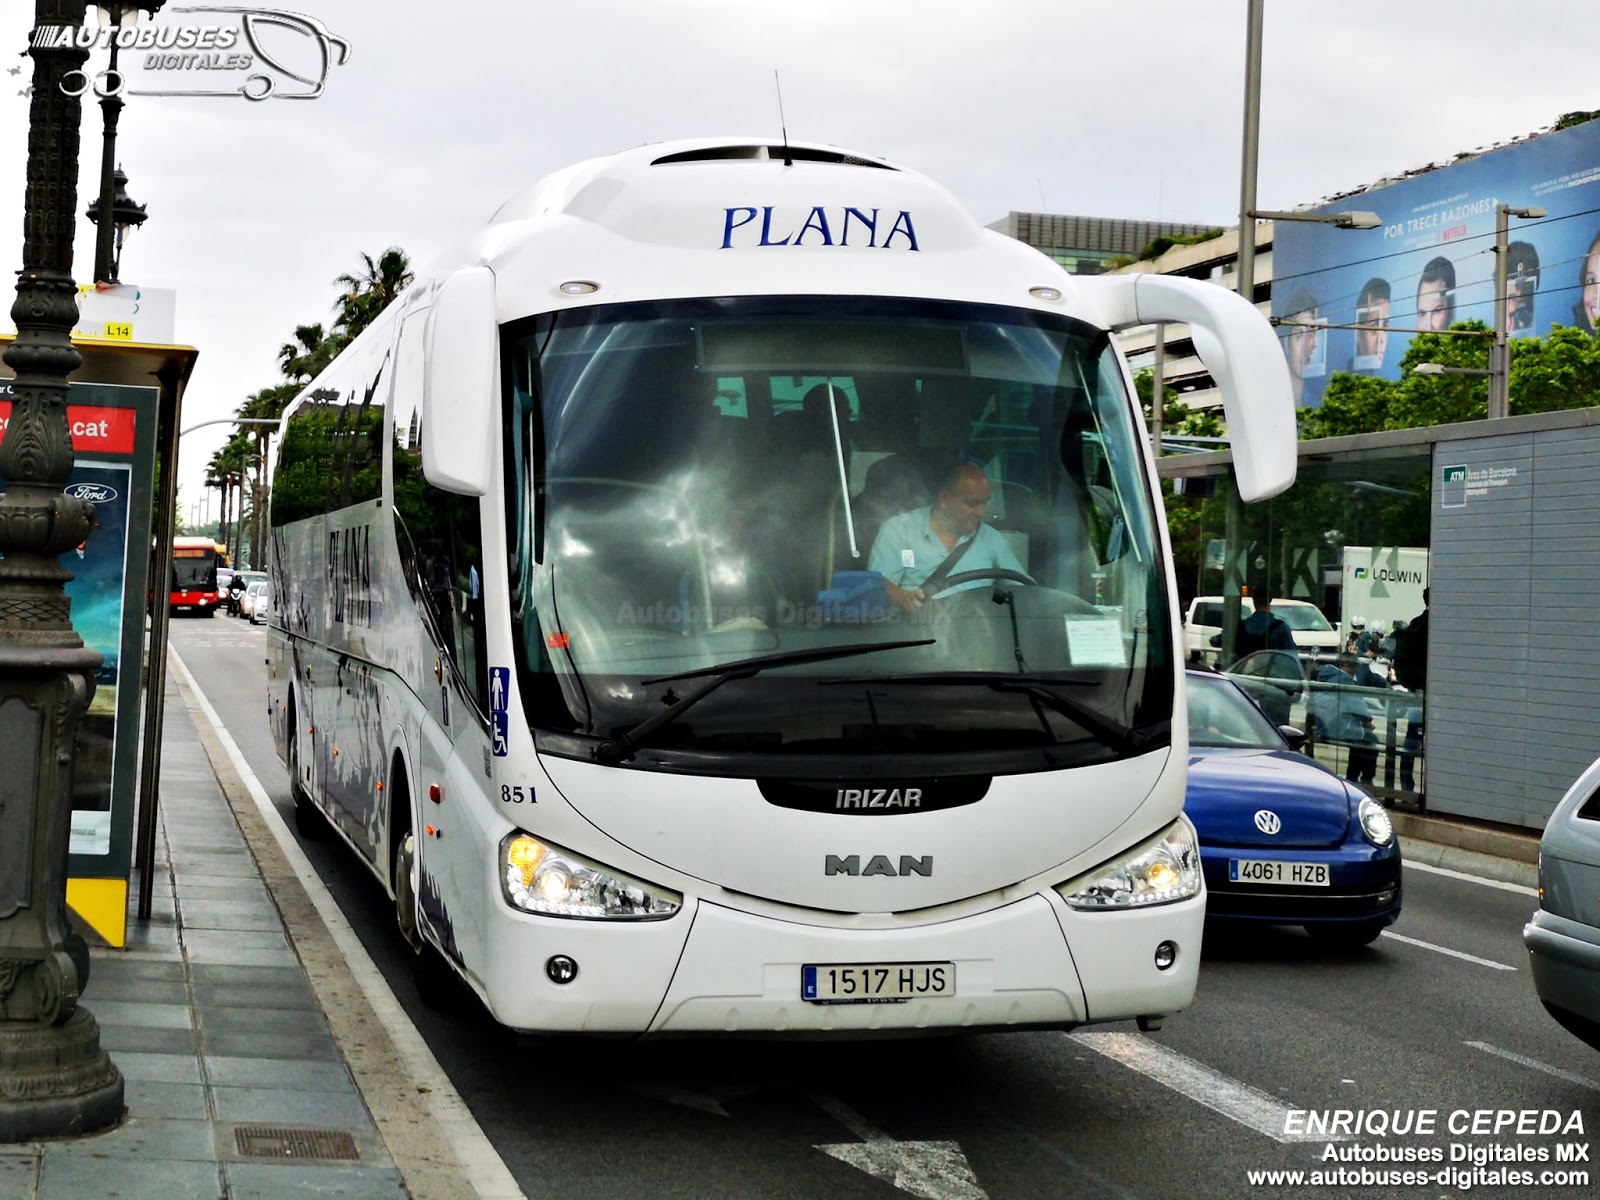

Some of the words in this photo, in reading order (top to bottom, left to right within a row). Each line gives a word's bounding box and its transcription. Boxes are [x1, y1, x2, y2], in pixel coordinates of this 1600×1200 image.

[719, 206, 921, 252] PLANA
[1383, 223, 1404, 240] POR
[1407, 212, 1440, 233] TRECE
[1441, 198, 1490, 225] RAZONES
[1442, 224, 1468, 240] NETFLIX
[1450, 471, 1465, 482] ATM
[74, 485, 108, 500] Ford
[501, 784, 538, 803] 851
[836, 788, 922, 808] IRIZAR
[825, 855, 933, 876] MAN
[1242, 862, 1282, 881] 4061
[1292, 865, 1326, 883] HZB
[829, 969, 889, 994] 1517
[899, 968, 946, 993] HJS
